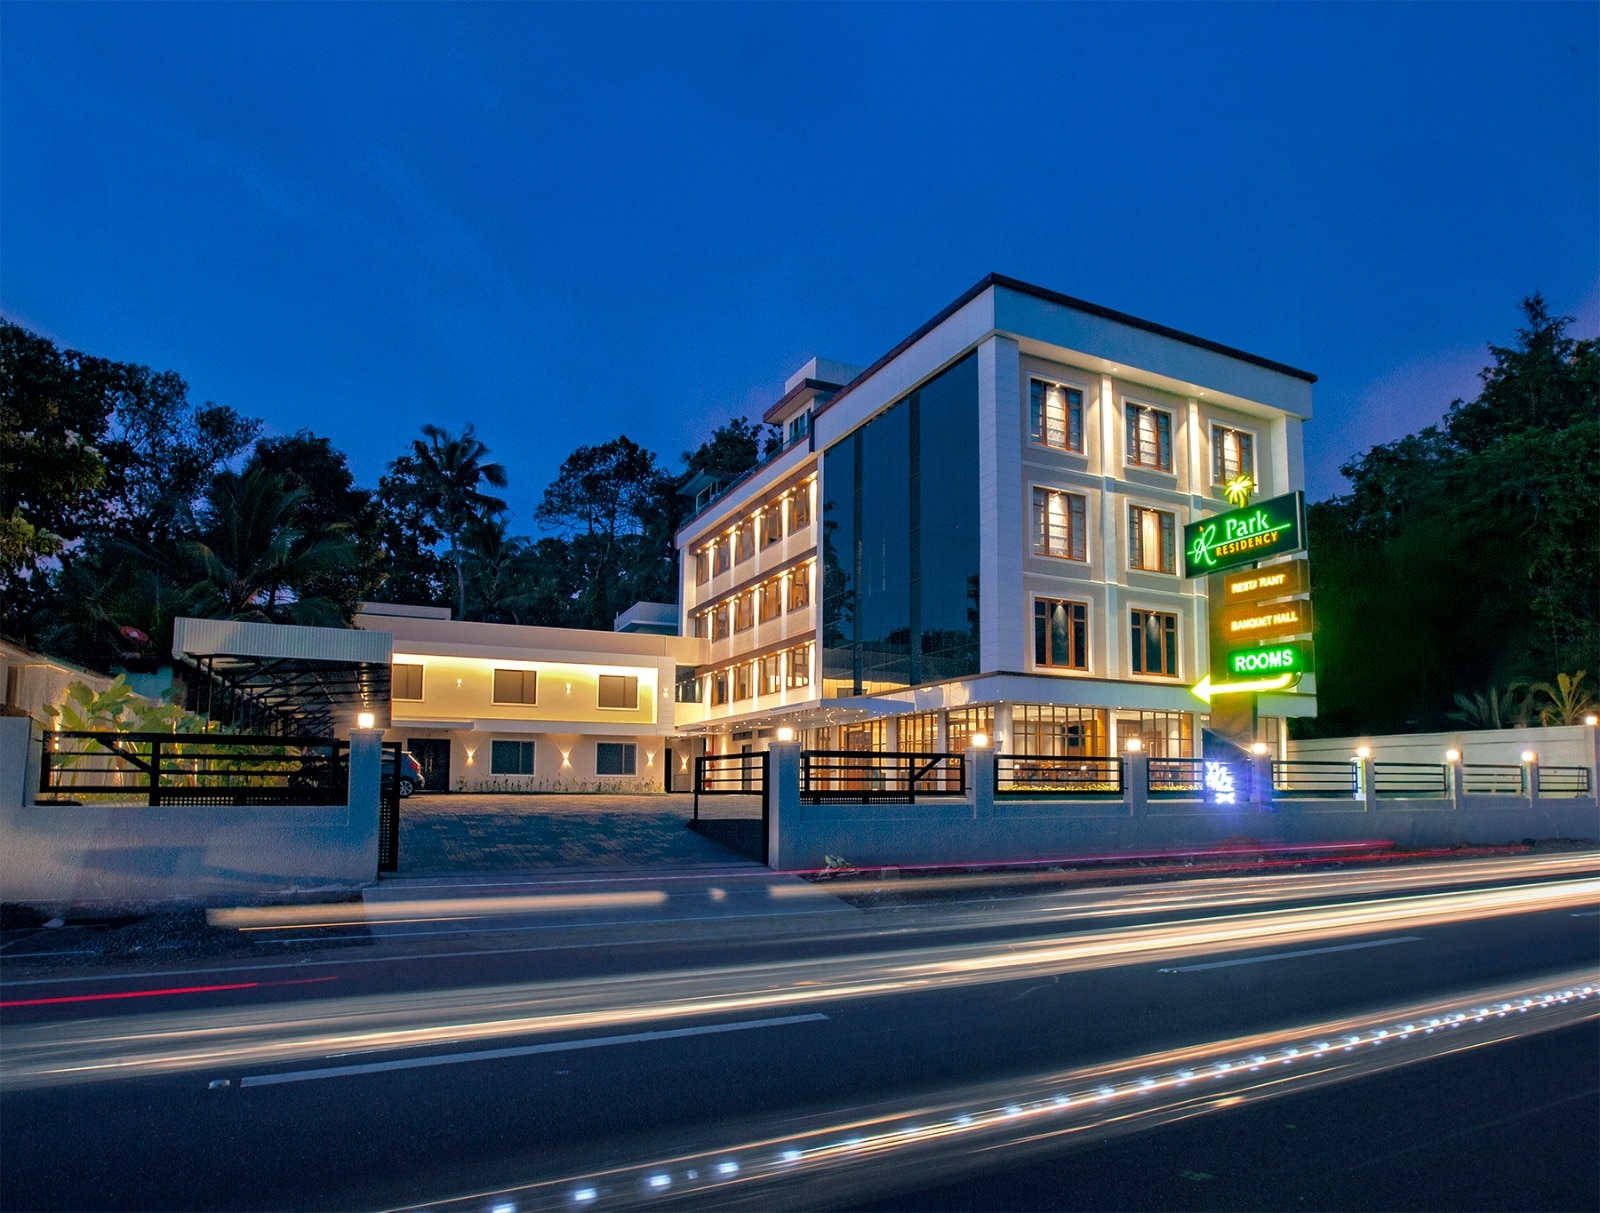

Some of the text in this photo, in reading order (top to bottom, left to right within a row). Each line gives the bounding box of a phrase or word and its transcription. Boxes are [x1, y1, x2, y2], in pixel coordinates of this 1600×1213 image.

[1226, 510, 1270, 540] Park
[1216, 531, 1278, 557] RESIDENCY
[1231, 611, 1299, 631] BANQUET HALL
[1235, 649, 1293, 672] ROOMS
